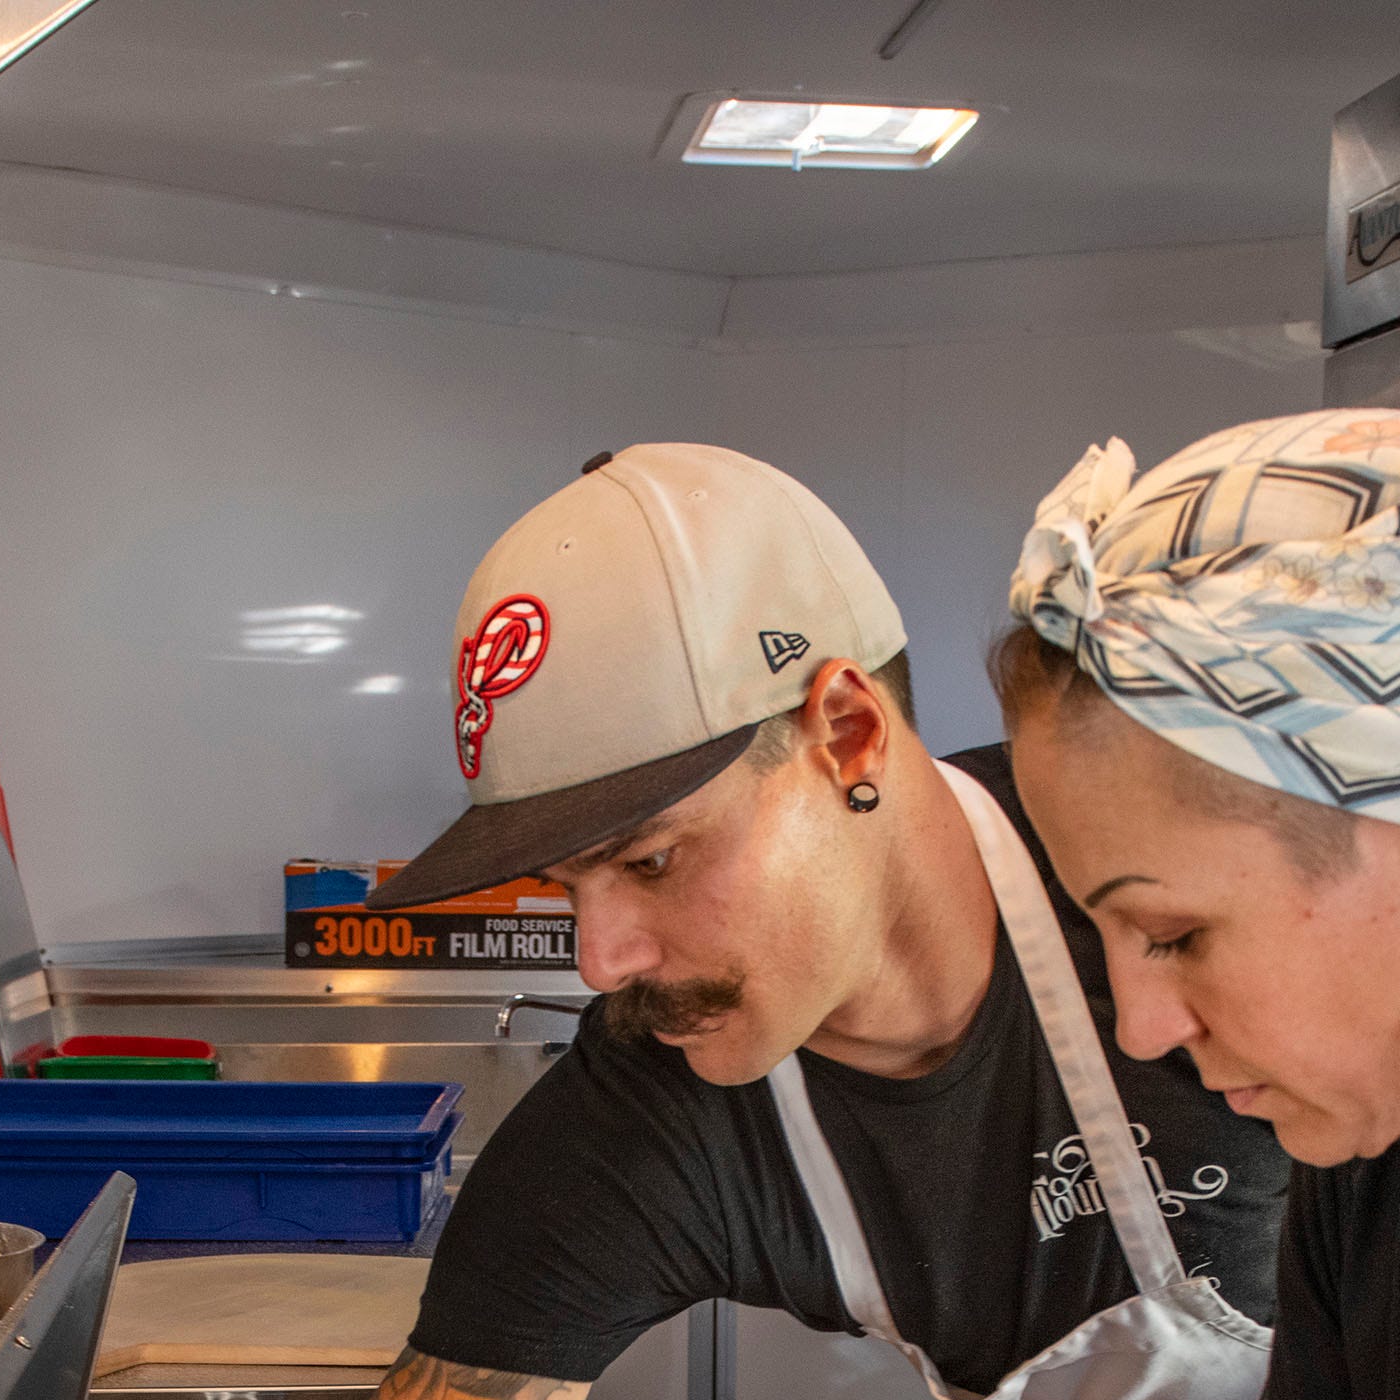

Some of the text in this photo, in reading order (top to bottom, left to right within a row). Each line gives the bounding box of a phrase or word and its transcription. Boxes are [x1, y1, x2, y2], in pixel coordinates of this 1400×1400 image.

[486, 919, 572, 932] FOOD SERVICE
[450, 933, 572, 959] FILM ROLL
